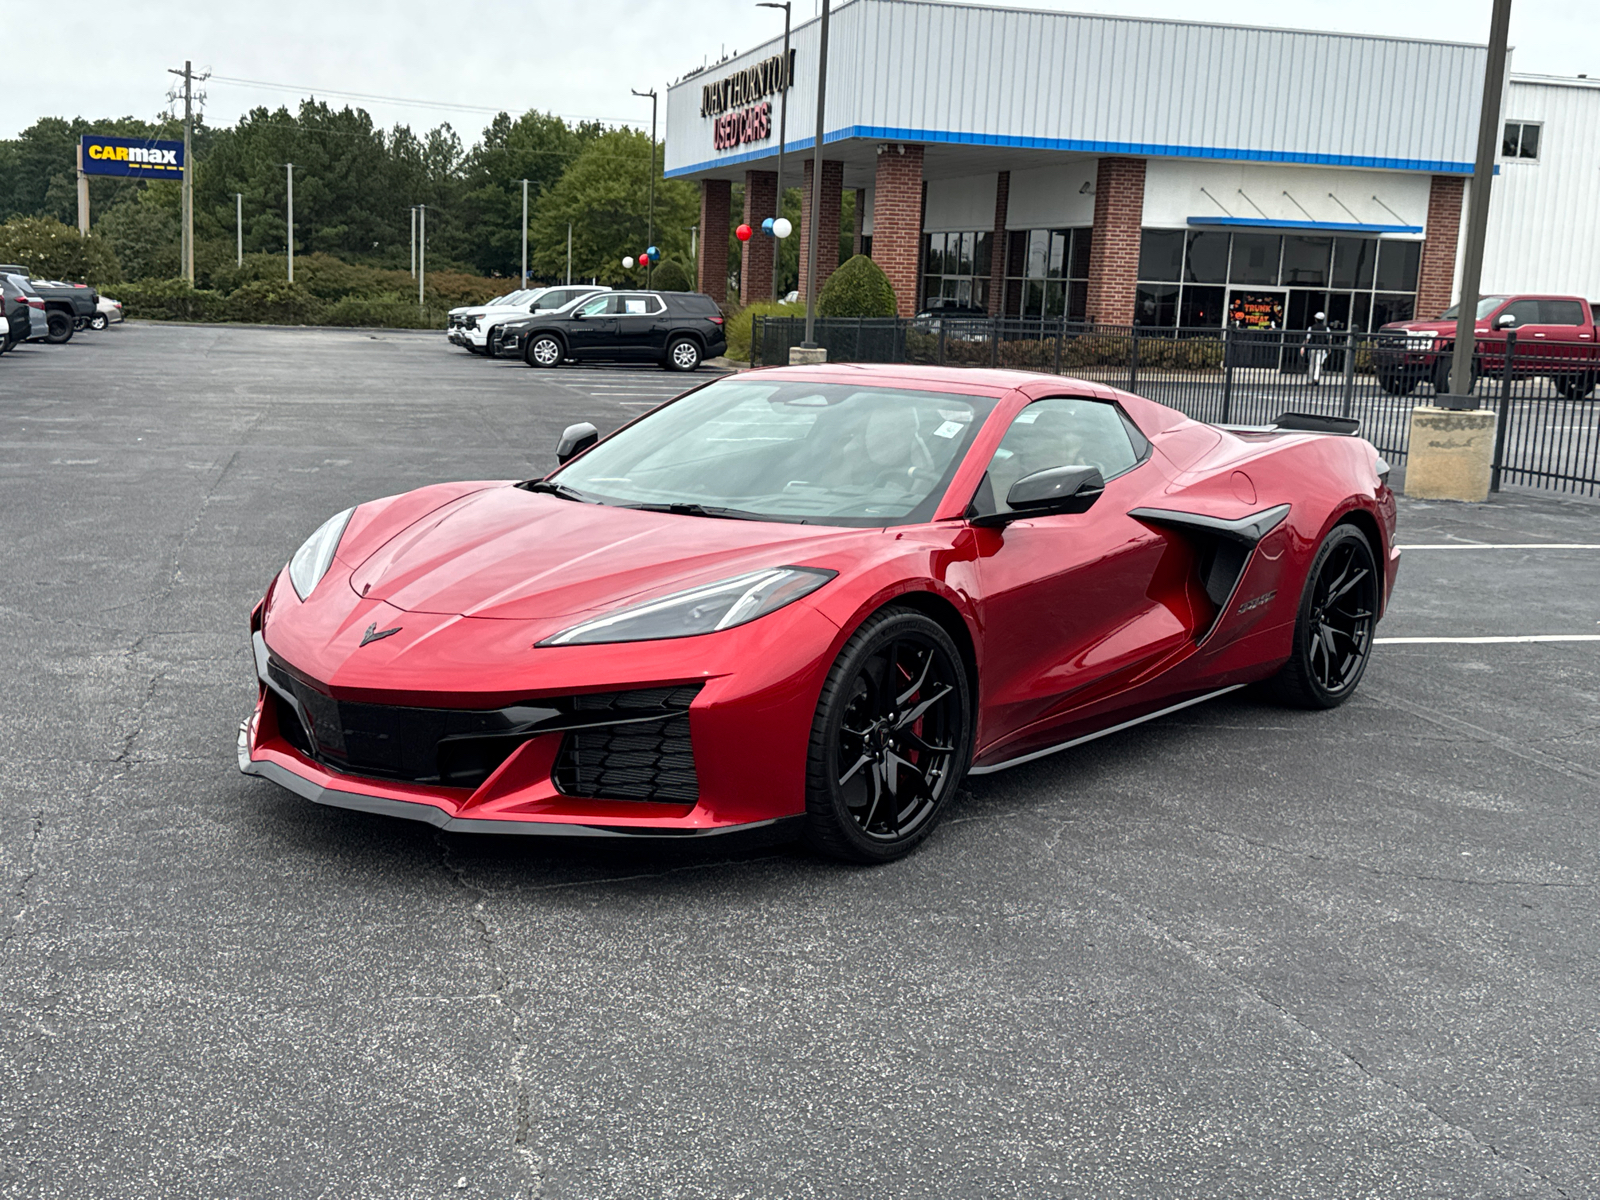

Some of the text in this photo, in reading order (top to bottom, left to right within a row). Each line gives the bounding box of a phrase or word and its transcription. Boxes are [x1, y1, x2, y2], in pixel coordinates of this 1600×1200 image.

[700, 79, 727, 117] JOHN
[713, 101, 772, 150] USED CARS
[88, 144, 177, 165] CARmax
[1244, 304, 1271, 312] TRUNK
[1245, 315, 1269, 323] TREAT
